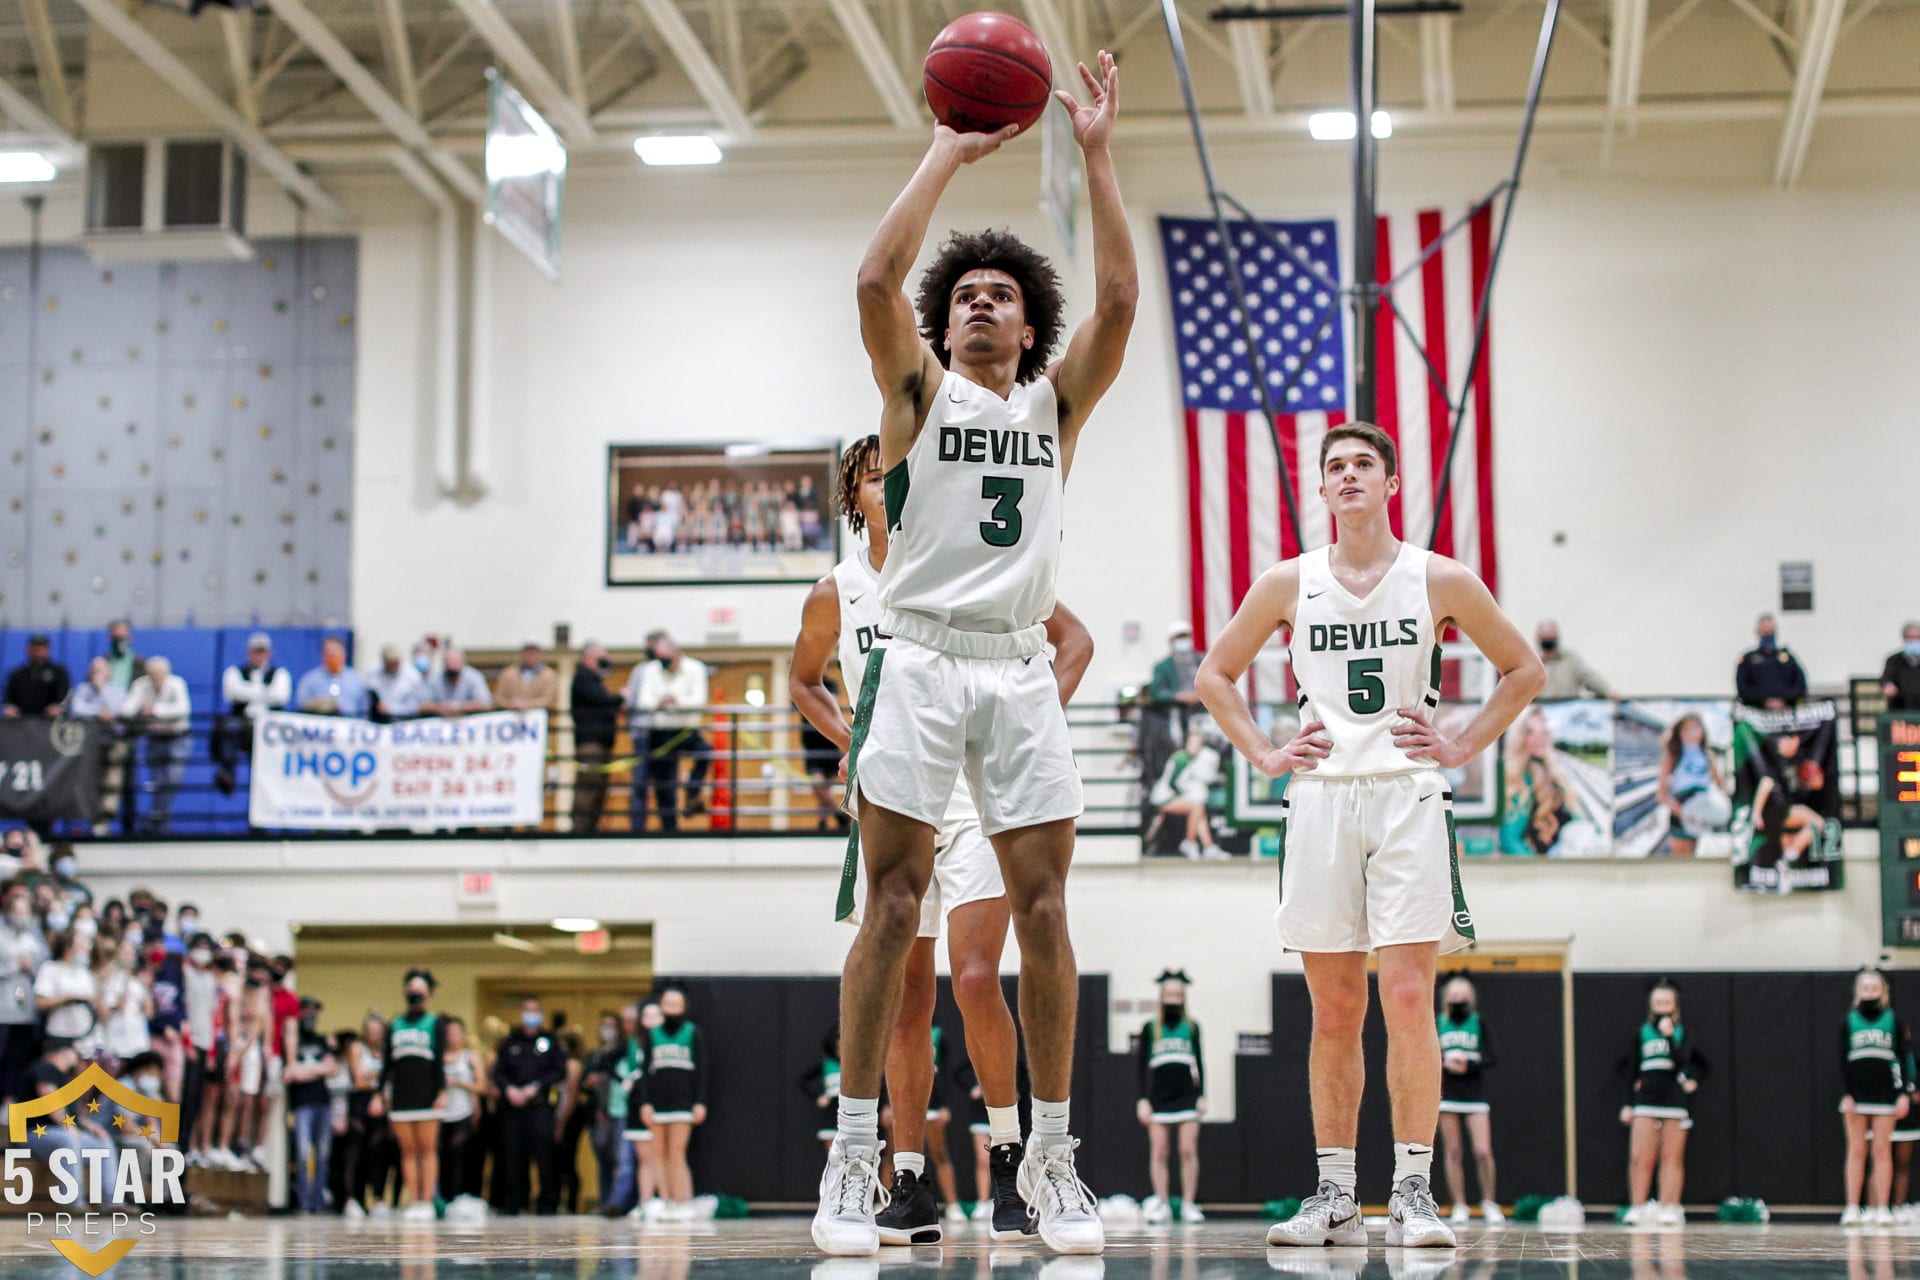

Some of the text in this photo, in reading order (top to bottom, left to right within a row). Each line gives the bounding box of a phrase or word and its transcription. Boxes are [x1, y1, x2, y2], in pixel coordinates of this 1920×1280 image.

[938, 427, 1055, 467] DEVILS
[979, 475, 1025, 547] 3
[1309, 618, 1419, 652] DEVILS
[1347, 658, 1385, 715] 5
[262, 719, 540, 747] COME TO BAILEYTON
[12, 759, 43, 792] 21
[391, 754, 455, 772] OPEN
[1808, 816, 1843, 862] 12
